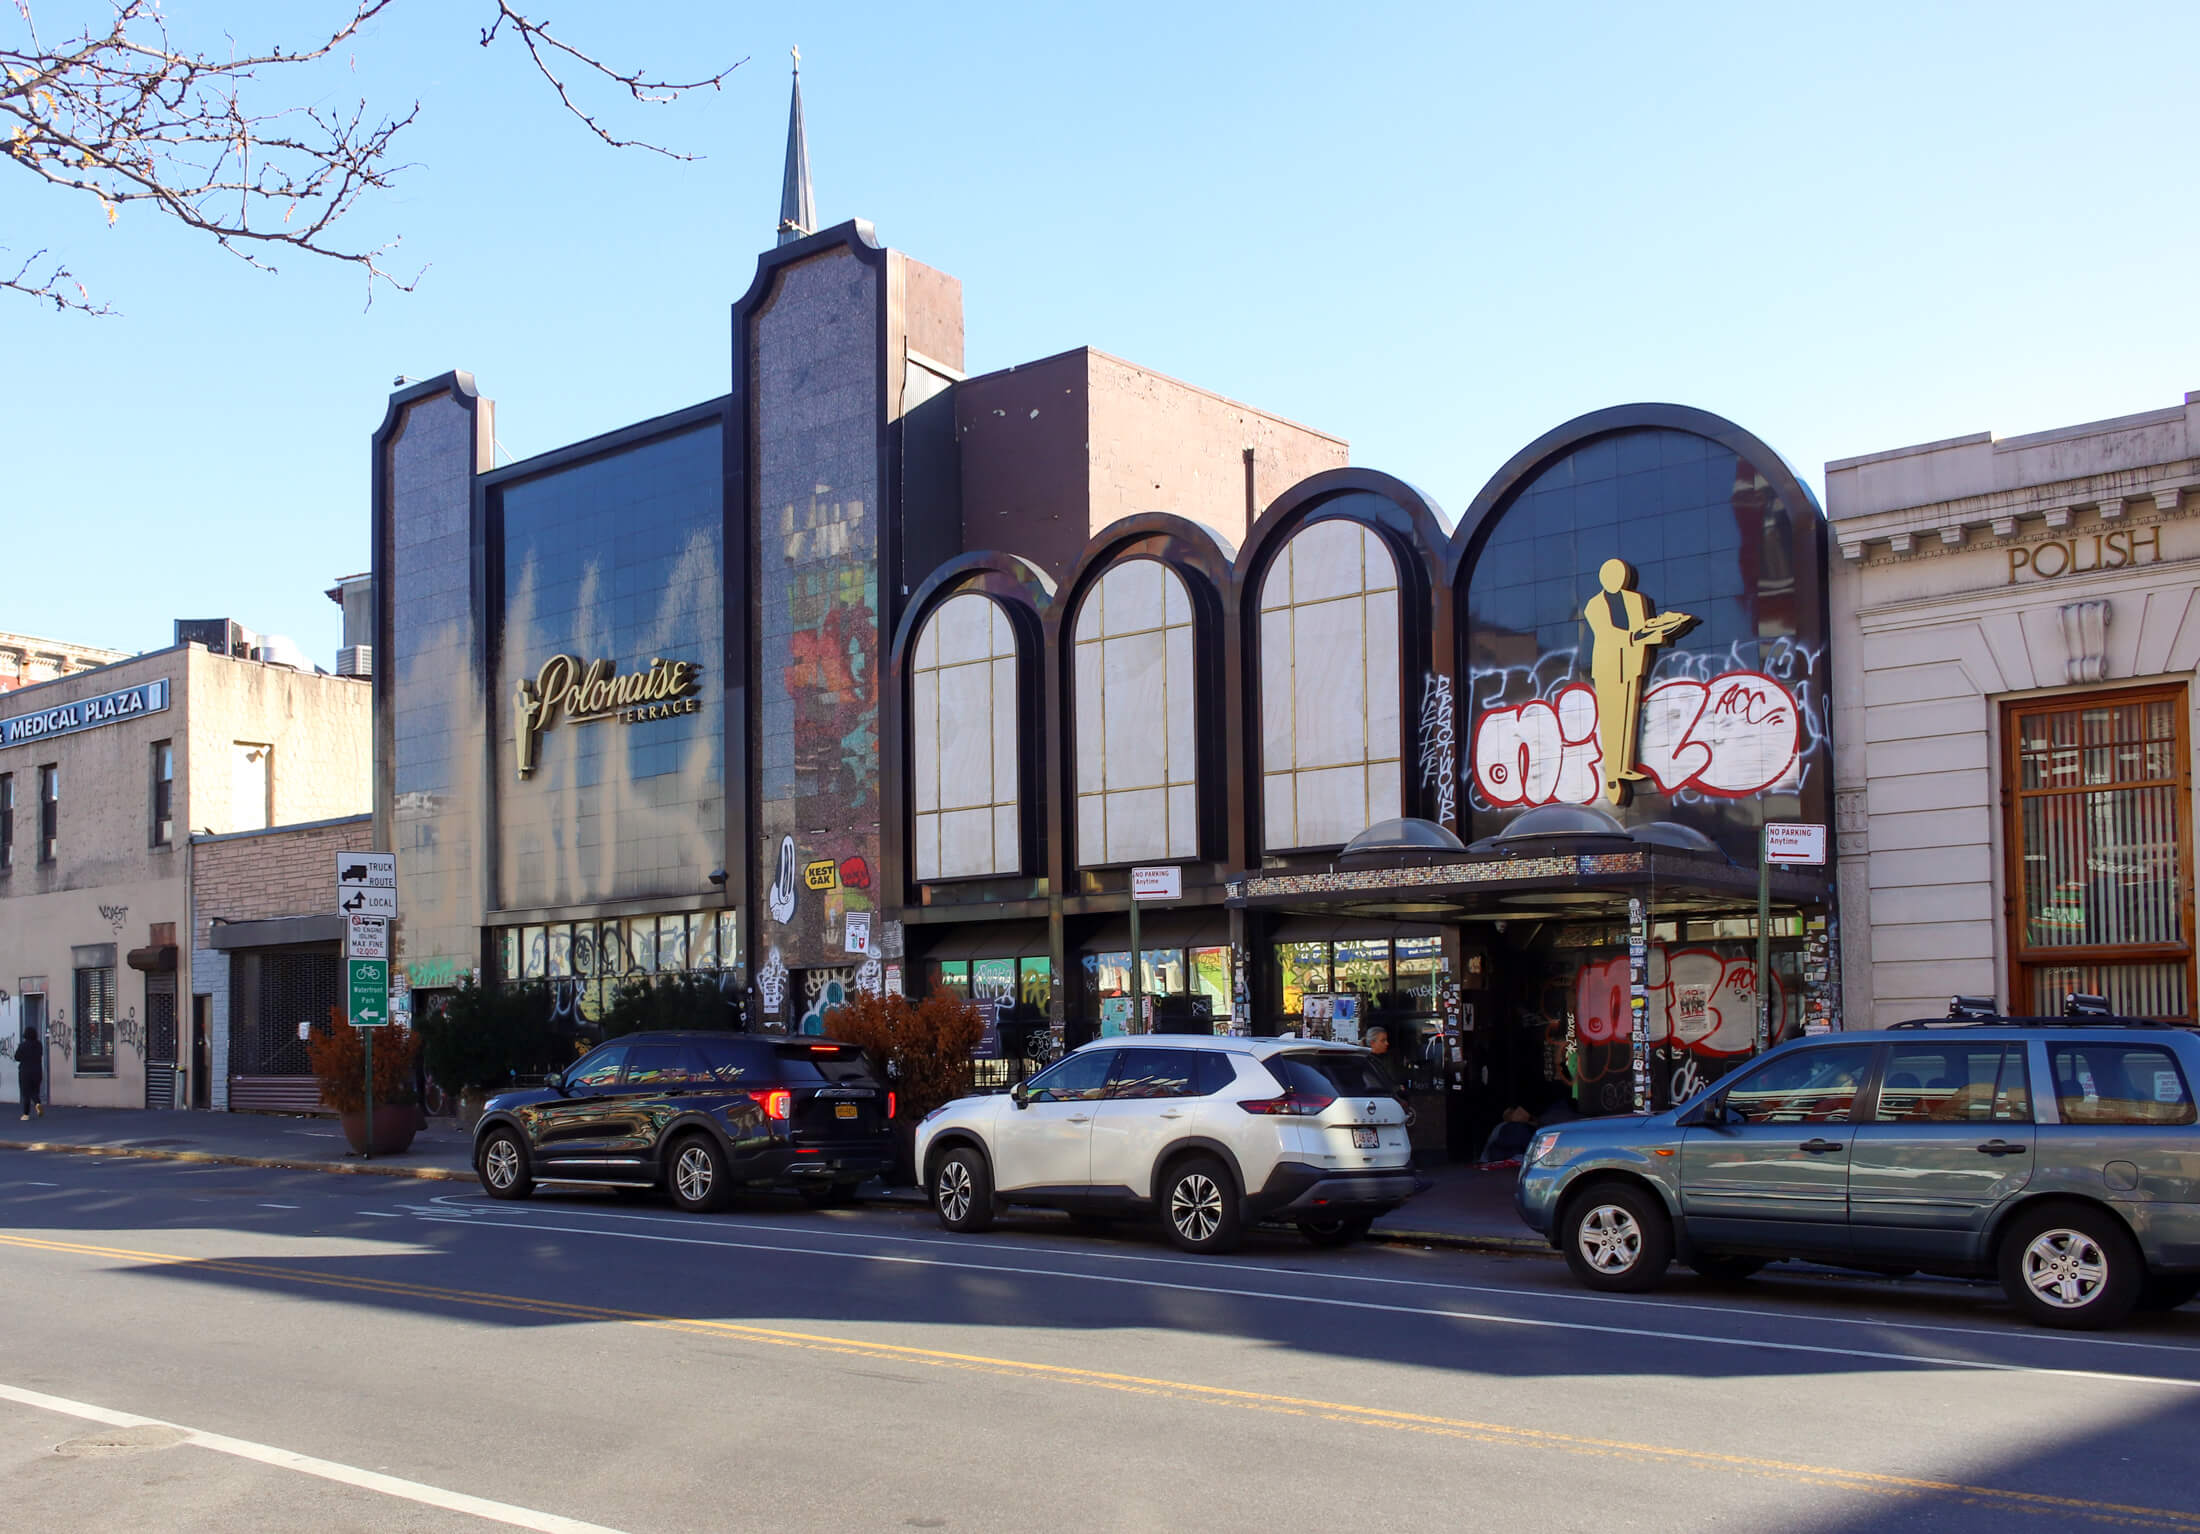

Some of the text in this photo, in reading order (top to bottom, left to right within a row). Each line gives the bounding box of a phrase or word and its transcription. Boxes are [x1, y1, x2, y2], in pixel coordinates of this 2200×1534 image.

[2007, 525, 2162, 584] POLISH
[532, 653, 689, 731] Polonaise
[10, 707, 79, 740] MEDICAL
[85, 691, 144, 722] PLAZA
[615, 698, 693, 723] TERRACE
[1782, 828, 1812, 837] PARKING
[1770, 837, 1798, 846] Anytime
[368, 862, 393, 872] TRUCK
[808, 866, 834, 877] KEST
[369, 877, 393, 887] ROUTE
[810, 875, 831, 885] GAK
[369, 898, 393, 907] LOCAL
[352, 940, 367, 948] MAX
[353, 986, 384, 994] Waterfront
[361, 996, 376, 1004] Park
